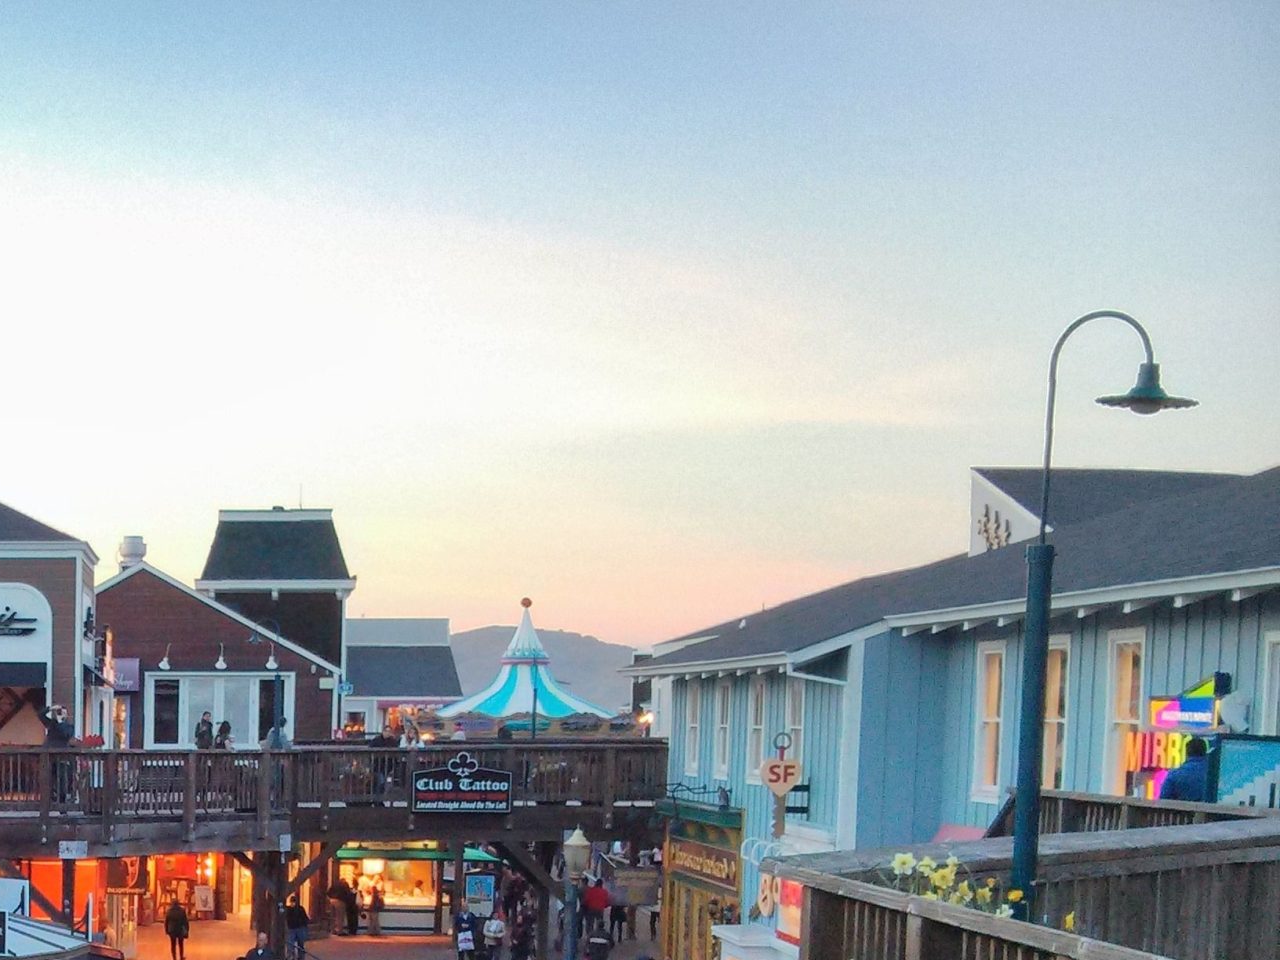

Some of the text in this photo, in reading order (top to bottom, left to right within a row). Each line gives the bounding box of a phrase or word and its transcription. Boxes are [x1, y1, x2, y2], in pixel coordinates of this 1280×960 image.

[768, 764, 796, 783] SF
[416, 778, 508, 791] Club Tattoo
